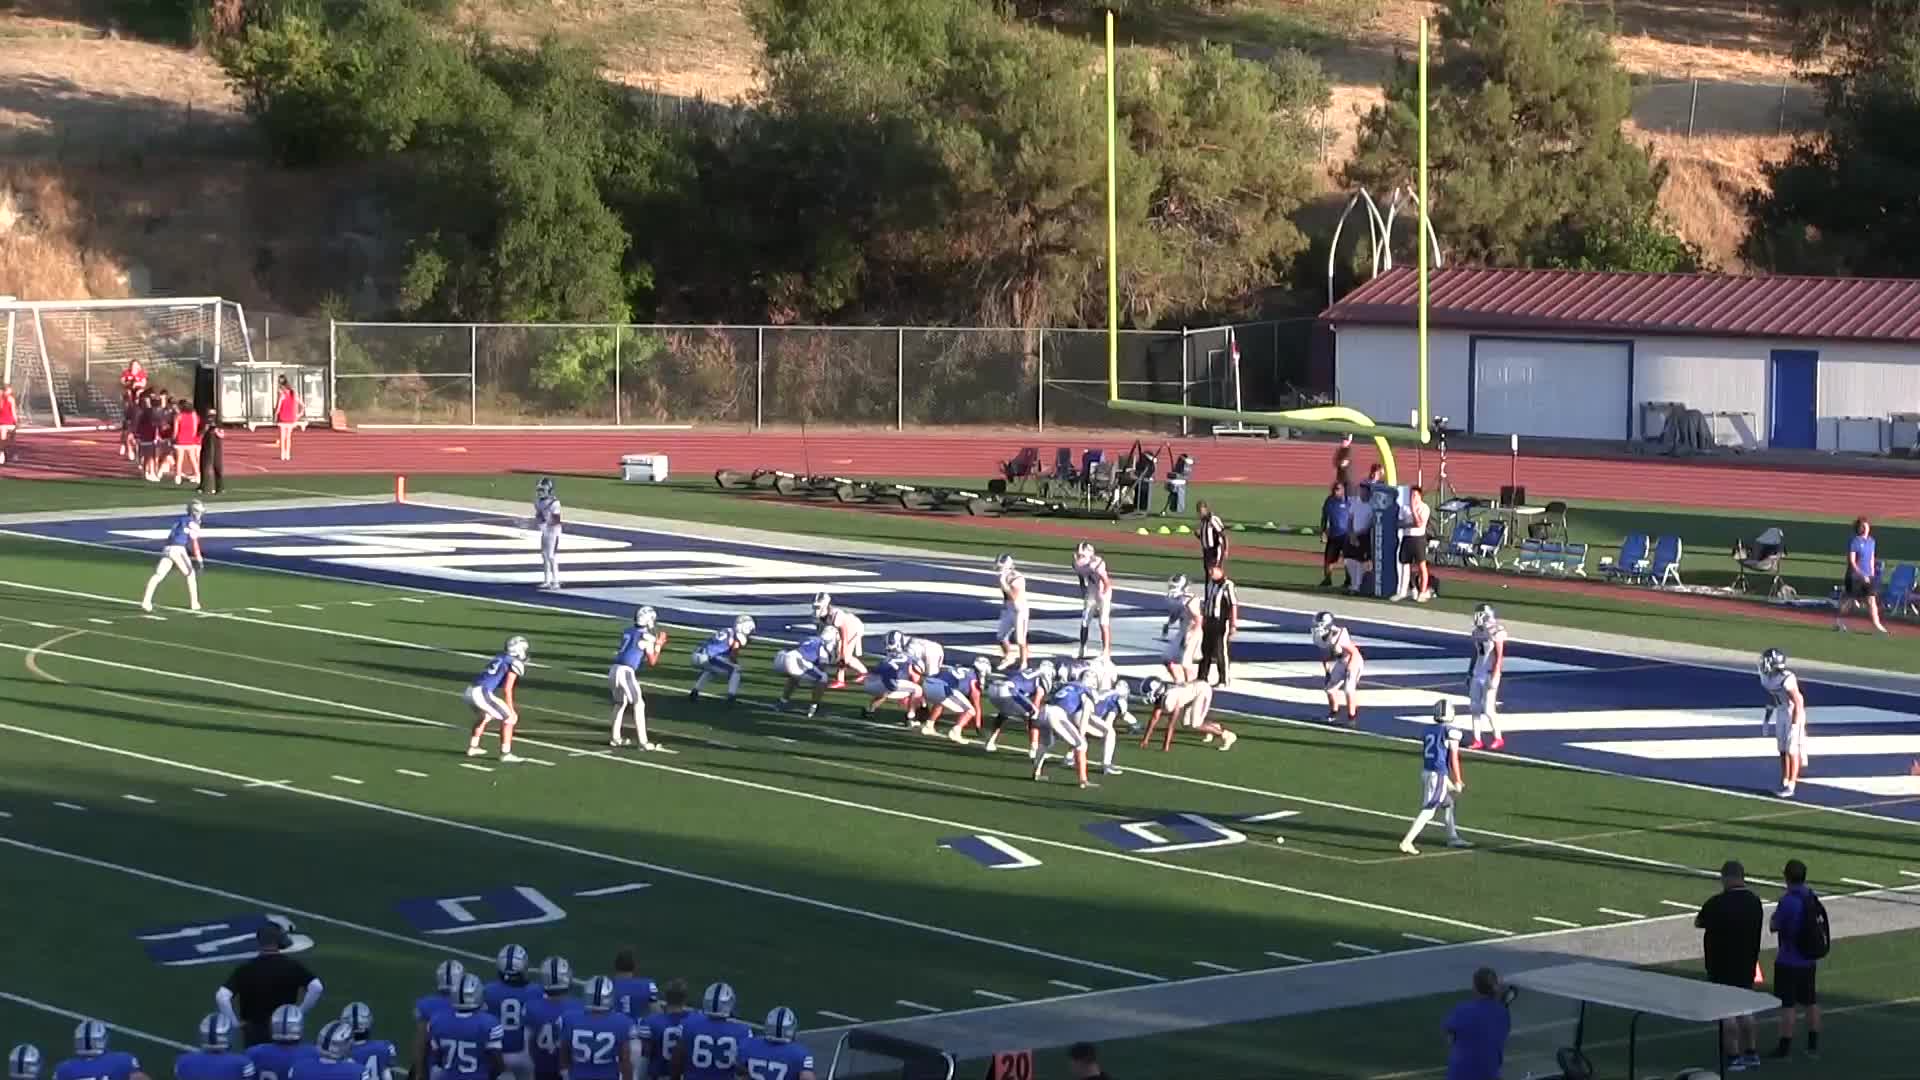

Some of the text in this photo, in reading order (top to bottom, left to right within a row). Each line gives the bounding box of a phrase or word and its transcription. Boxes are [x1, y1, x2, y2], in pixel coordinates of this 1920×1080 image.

[439, 1039, 478, 1074] 75
[571, 1029, 617, 1064] 52
[692, 1034, 738, 1069] 63
[1001, 1053, 1030, 1080] 20
